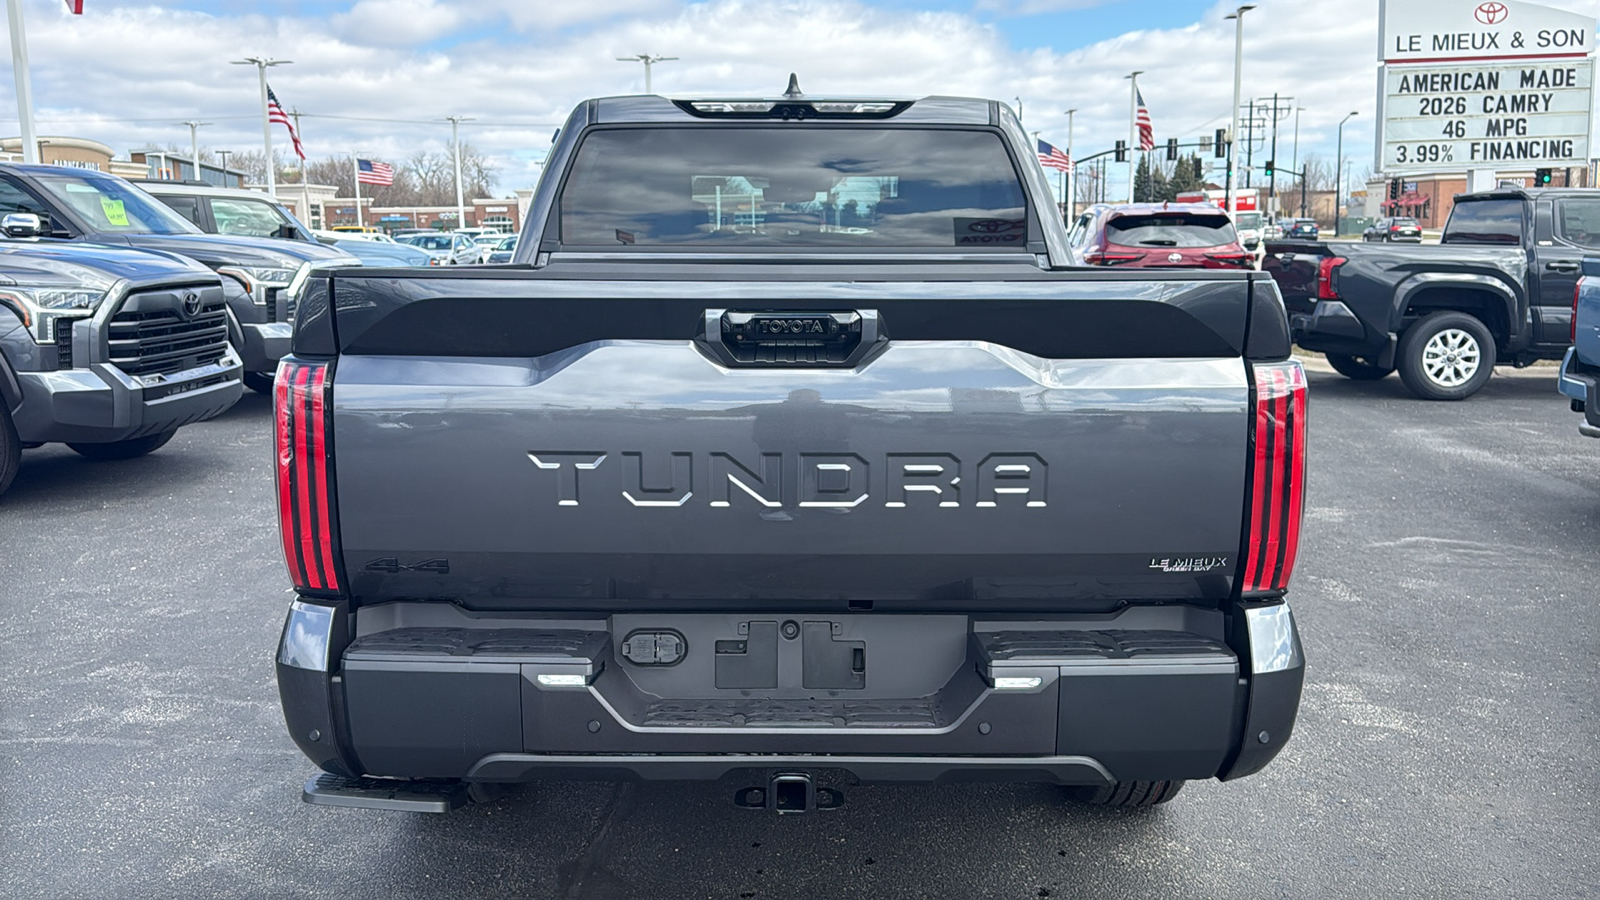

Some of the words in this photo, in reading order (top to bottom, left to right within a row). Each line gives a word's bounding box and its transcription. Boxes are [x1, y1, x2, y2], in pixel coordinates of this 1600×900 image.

[1396, 35, 1422, 52] LE
[1432, 32, 1500, 51] MIEUX
[1510, 31, 1525, 48] &
[1537, 29, 1585, 48] SON
[1398, 71, 1500, 93] AMERICAN
[1520, 68, 1576, 88] MADE
[1419, 97, 1467, 116] 2026
[1482, 93, 1553, 114] CAMRY
[1442, 121, 1466, 138] 46
[1485, 118, 1527, 137] MPG
[1396, 144, 1453, 163] 3.99%
[1470, 140, 1573, 160] FINANCING
[760, 319, 824, 333] TOYOTA
[527, 450, 1048, 507] TUNDRA
[1149, 558, 1170, 568] LE
[1173, 557, 1227, 568] MIEUX
